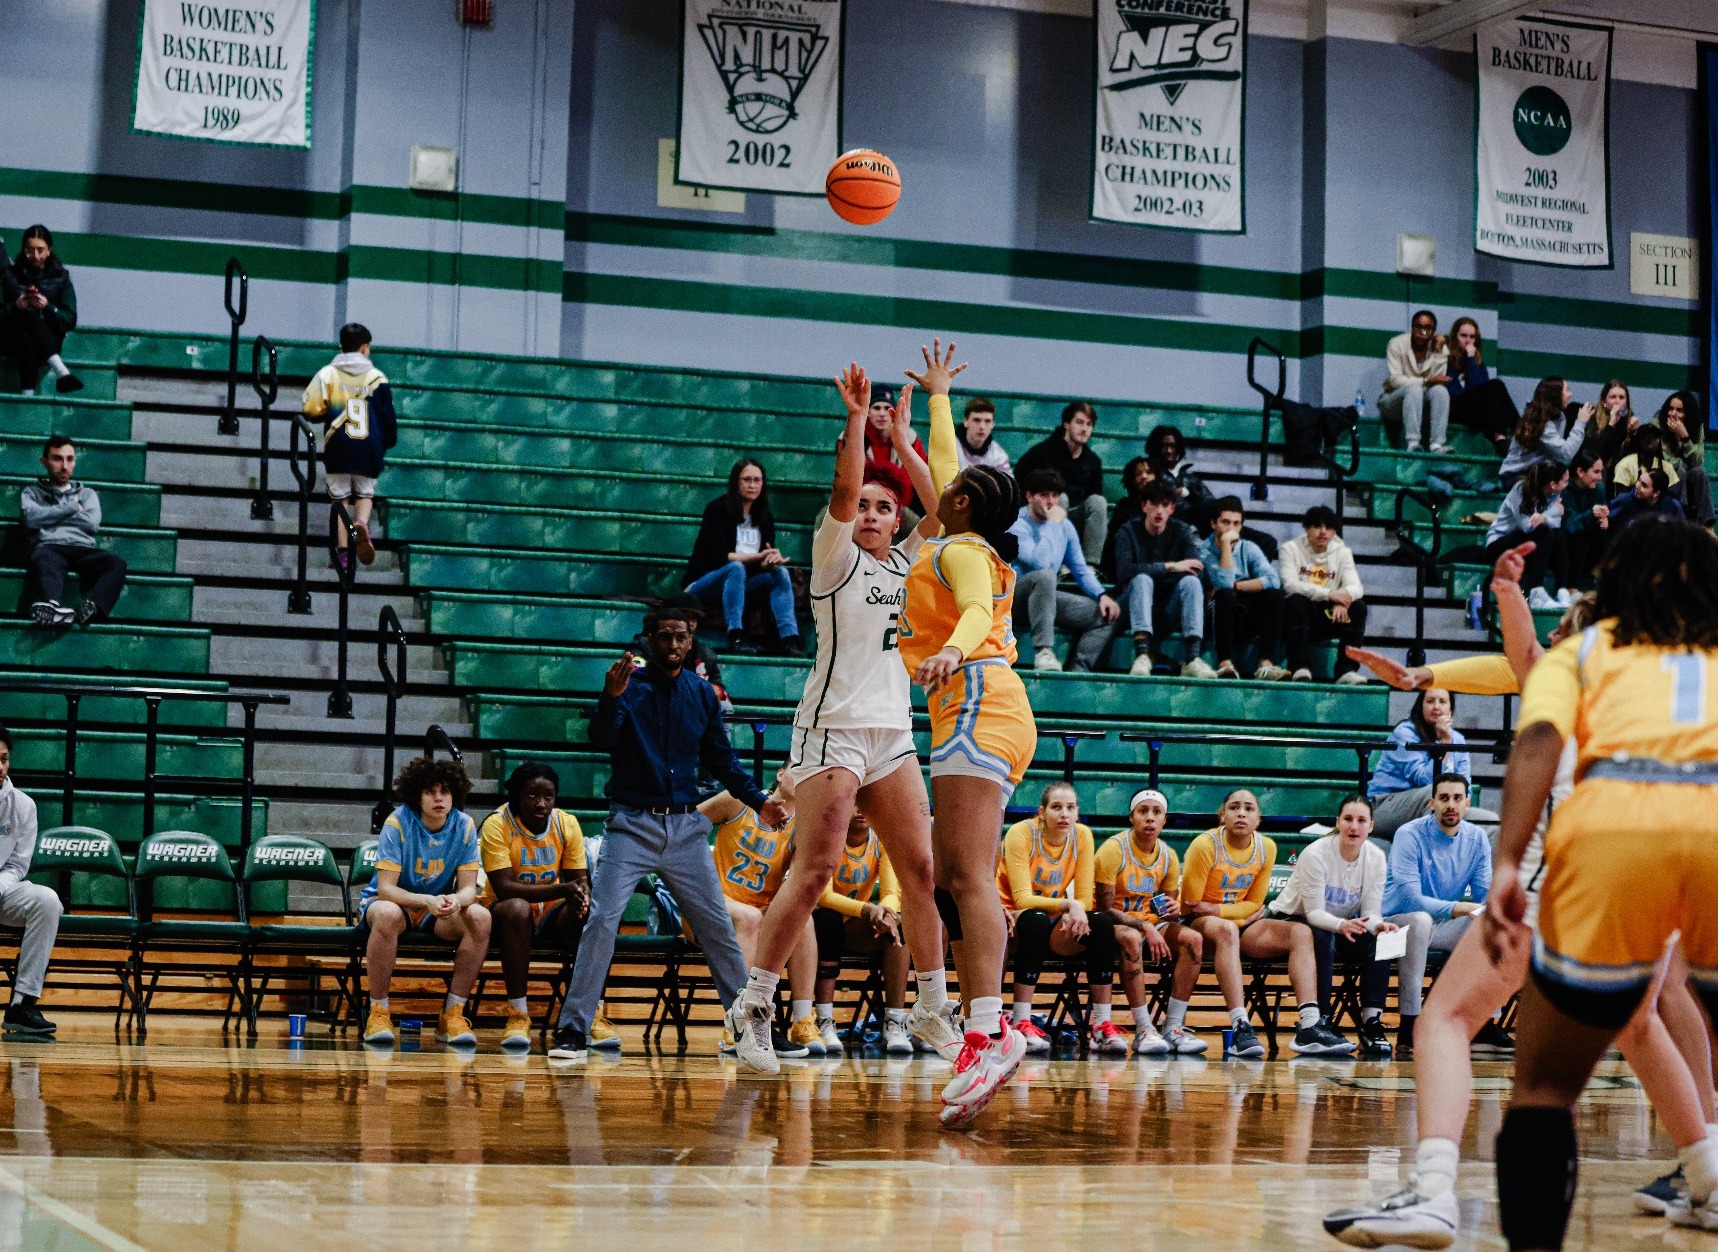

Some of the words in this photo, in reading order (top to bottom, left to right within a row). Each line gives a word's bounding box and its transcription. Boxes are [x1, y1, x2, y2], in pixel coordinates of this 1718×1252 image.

[181, 2, 274, 36] WOMEN'S
[1115, 0, 1231, 19] CONFERENCE
[163, 33, 288, 70] BASKETBALL
[720, 22, 814, 78] NIT
[1110, 18, 1239, 72] NEC
[1519, 28, 1570, 54] MEN'S
[1492, 47, 1598, 82] BASKETBALL
[165, 66, 283, 102] CHAMPIONS
[202, 105, 240, 131] 1989
[1138, 112, 1202, 136] MEN'S
[1517, 108, 1568, 129] NCAA
[726, 139, 792, 169] 2002
[1101, 134, 1236, 166] BASKETBALL
[1105, 163, 1231, 192] CHAMPIONS
[1524, 167, 1558, 190] 2003
[1133, 194, 1204, 217] 2002-03
[1495, 190, 1540, 209] MIDWEST
[1541, 197, 1589, 214] REGIONAL
[1639, 243, 1692, 260] SECTION
[1655, 263, 1678, 287] III
[345, 397, 369, 440] 9
[1661, 653, 1708, 724] 1
[40, 837, 110, 852] WAGNER
[147, 843, 220, 857] WAGNER
[255, 847, 326, 860] WAGNER
[520, 845, 556, 867] LIU
[738, 828, 778, 858] LIU
[415, 858, 446, 875] LIU
[726, 850, 770, 893] 23
